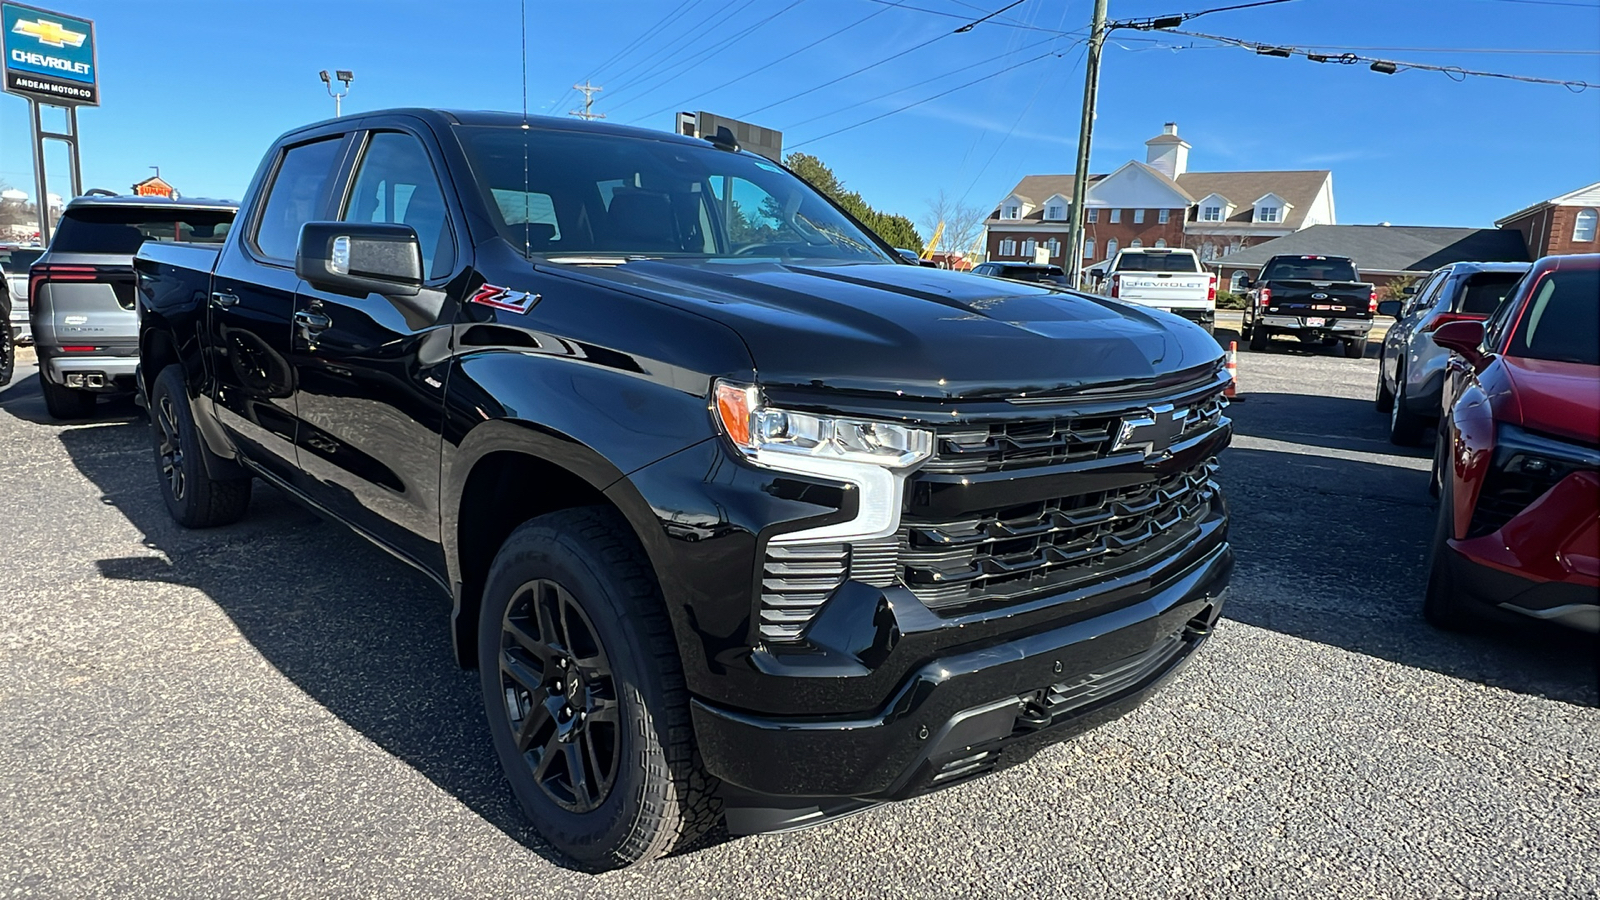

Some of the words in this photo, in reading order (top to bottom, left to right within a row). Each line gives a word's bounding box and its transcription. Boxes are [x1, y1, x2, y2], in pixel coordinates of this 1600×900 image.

[11, 49, 90, 75] CHEVROLET
[16, 78, 50, 91] ANDEAN
[51, 85, 79, 96] MOTOR
[79, 90, 91, 98] CO
